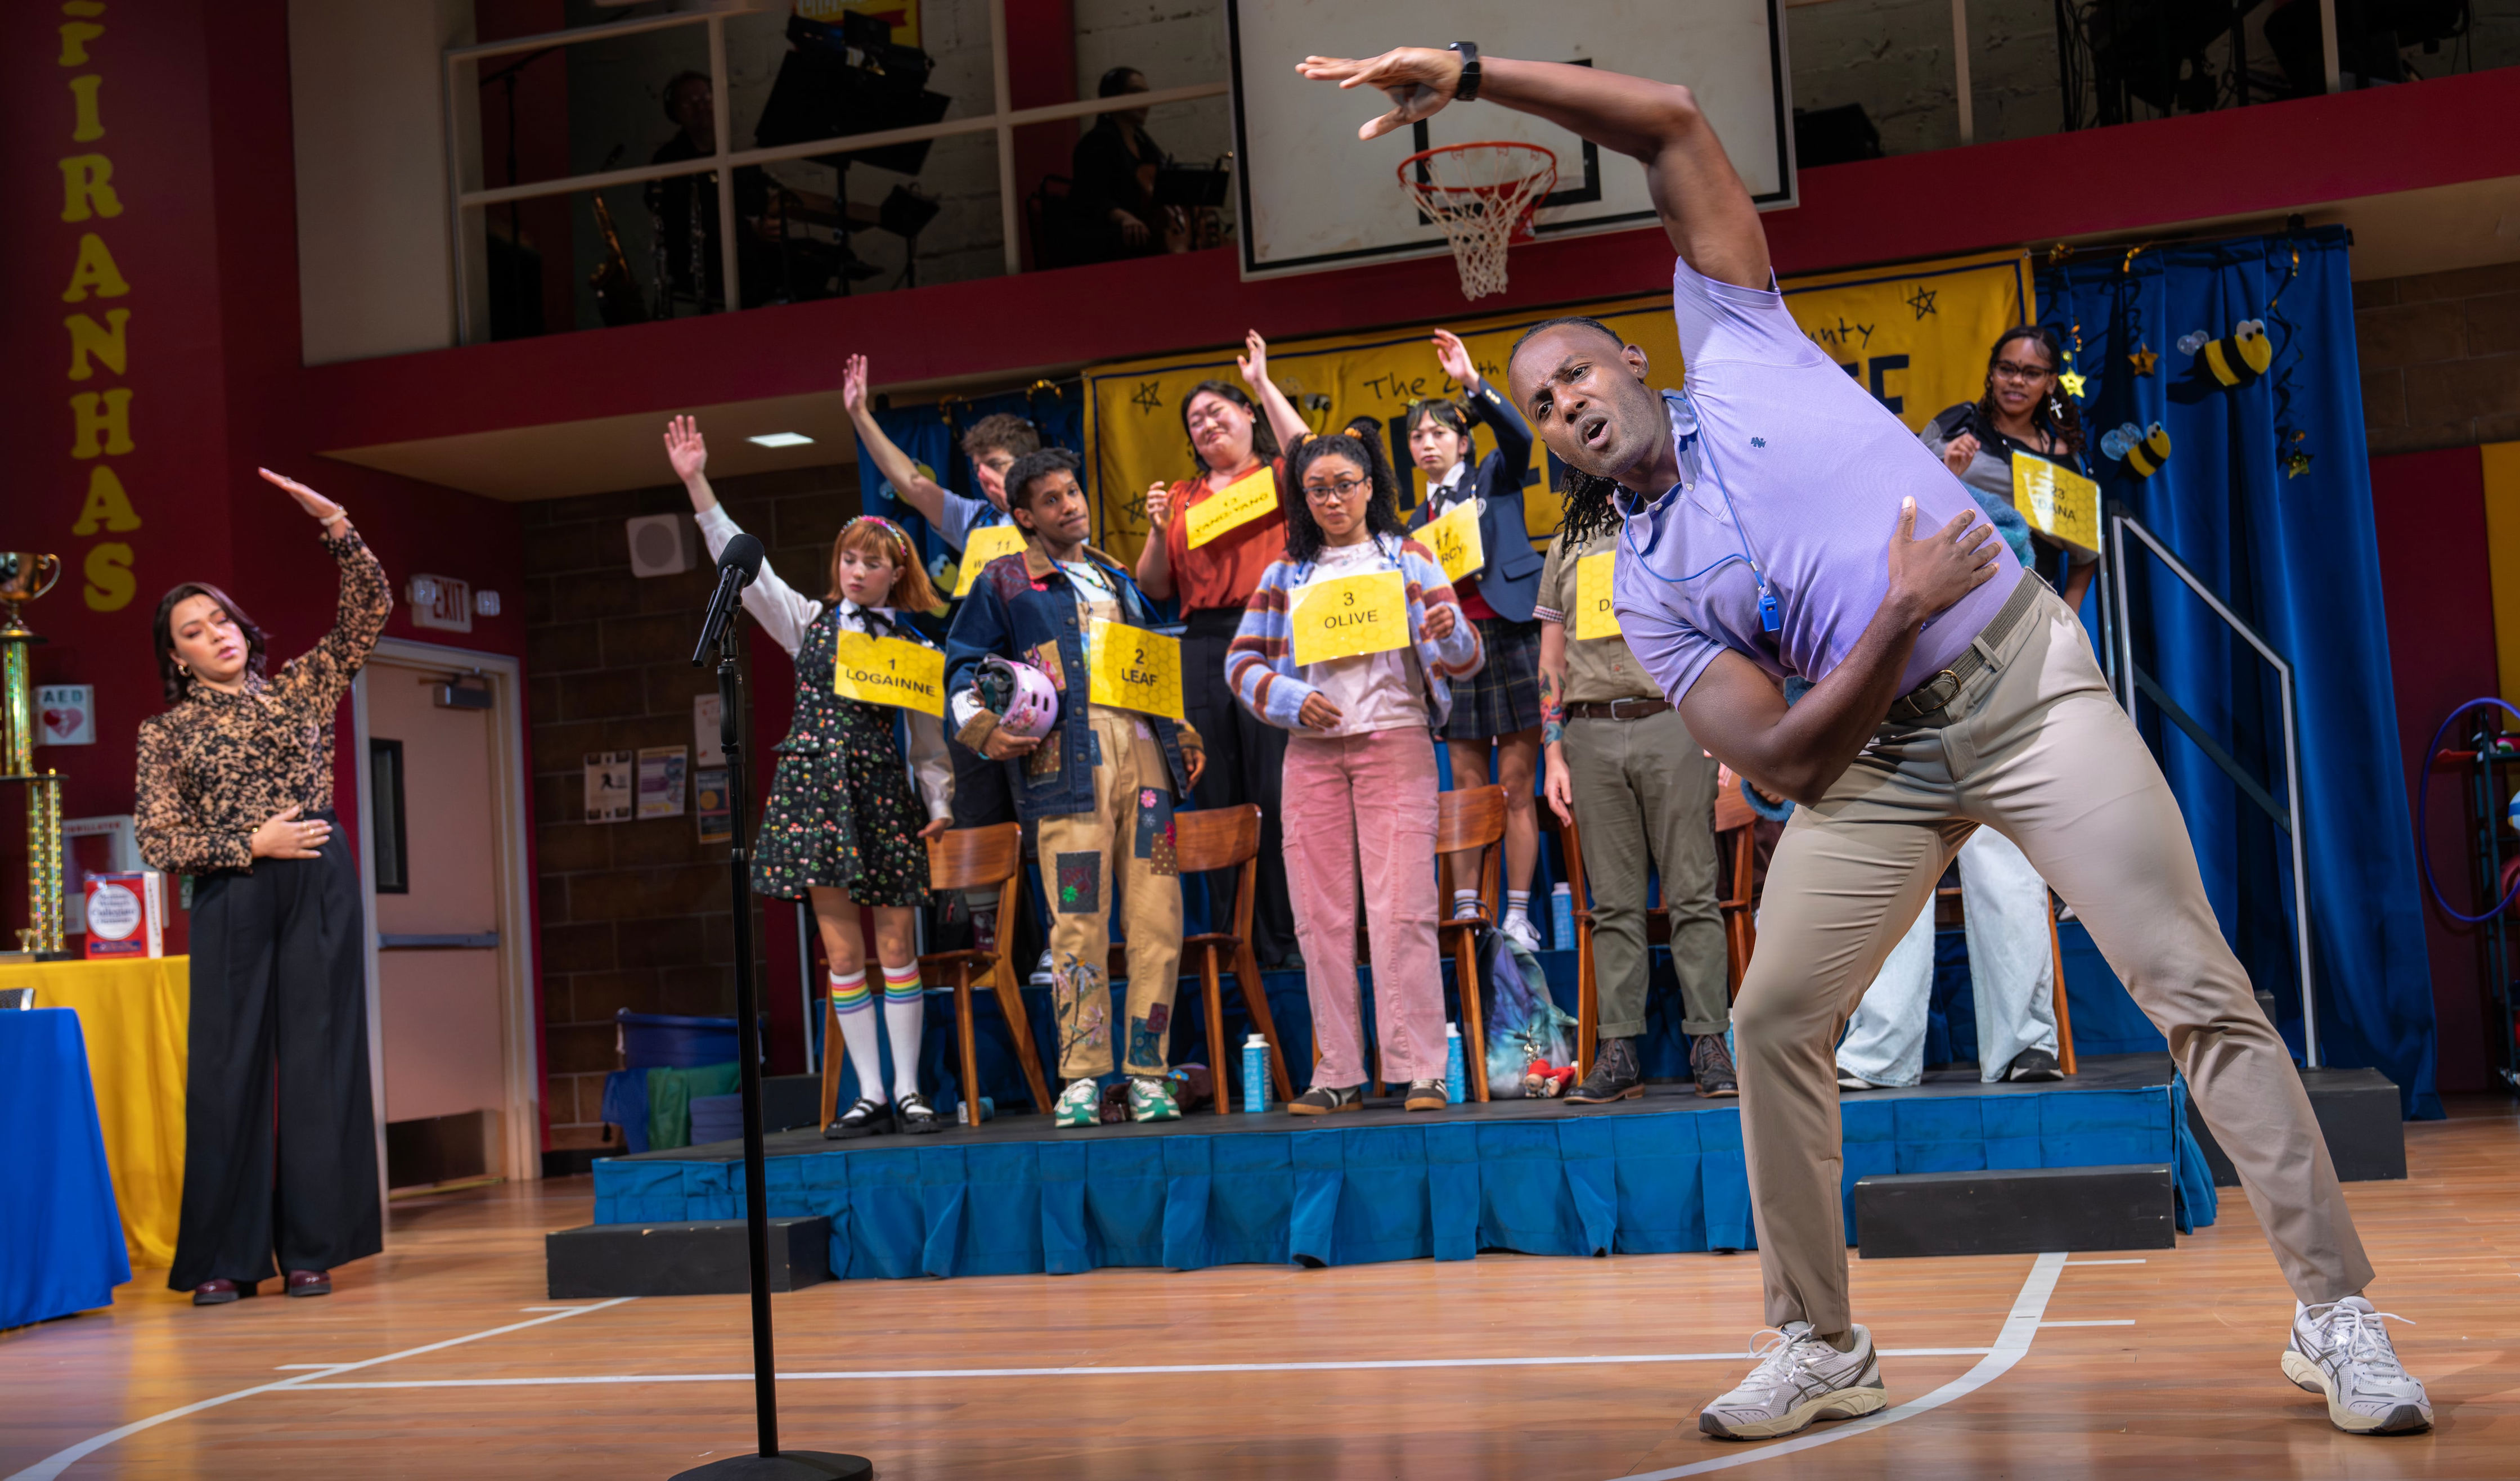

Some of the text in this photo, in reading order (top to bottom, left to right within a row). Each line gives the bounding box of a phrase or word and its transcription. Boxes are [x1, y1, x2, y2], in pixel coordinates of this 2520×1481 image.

[1363, 371, 1427, 399] The
[1439, 360, 1500, 394] 2th
[2051, 485, 2065, 500] 23
[2037, 498, 2077, 522] DANA
[996, 539, 1010, 552] 11
[1440, 543, 1463, 565] RCY
[1343, 592, 1355, 606] 3
[1324, 609, 1378, 629] OLIVE
[887, 658, 896, 671] 1
[1135, 648, 1145, 665] 2
[846, 668, 936, 697] LOGAINNE
[1121, 667, 1158, 687] LEAF
[43, 690, 83, 704] AED
